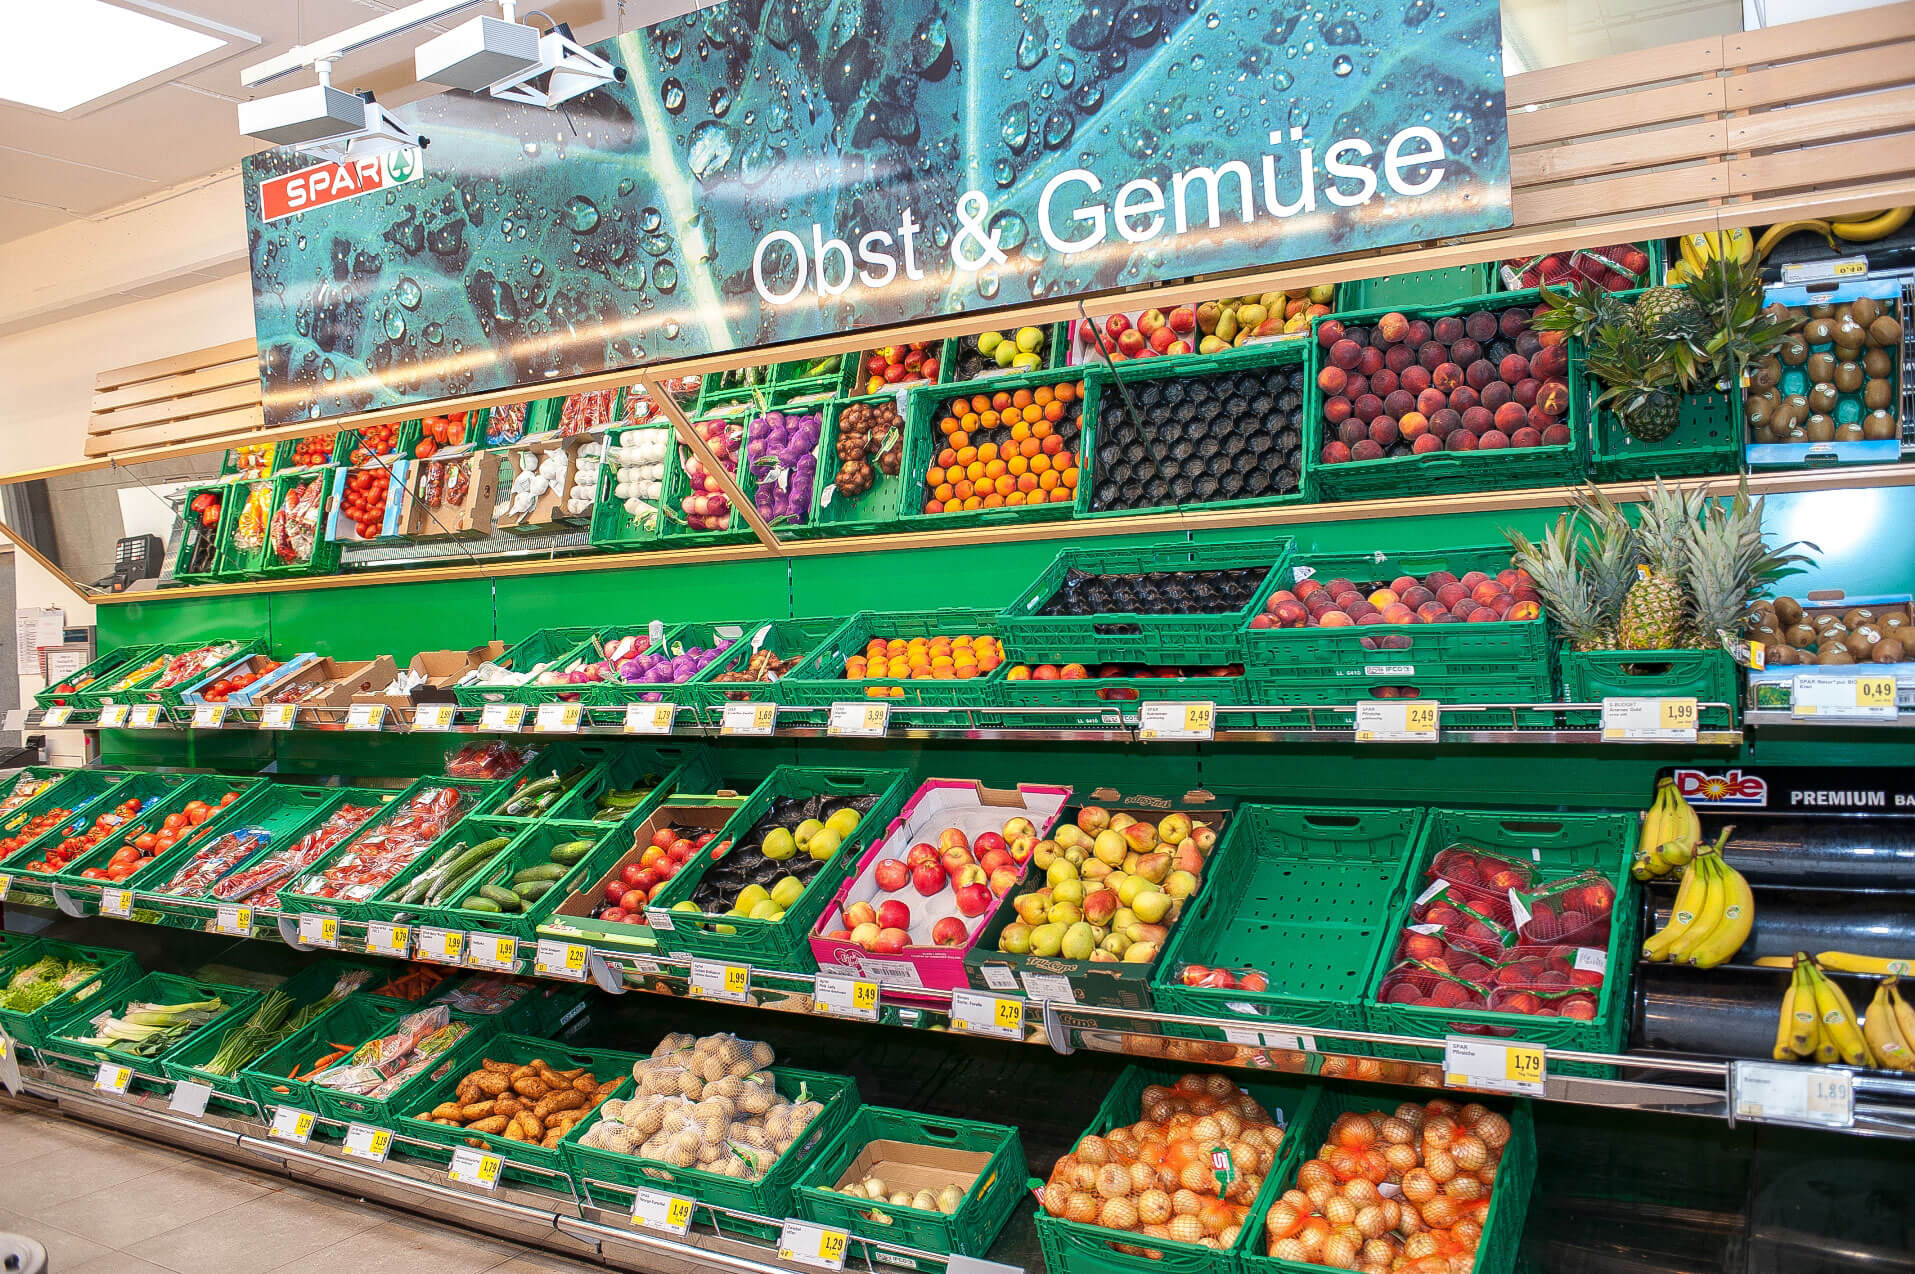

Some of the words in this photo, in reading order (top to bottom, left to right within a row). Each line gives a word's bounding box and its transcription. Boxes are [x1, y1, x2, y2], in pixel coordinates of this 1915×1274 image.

[286, 157, 380, 207] SPAR
[752, 205, 925, 306] Obst
[950, 189, 1009, 272] &
[1037, 125, 1447, 254] Gemüse
[1863, 683, 1892, 698] 0,49
[758, 710, 773, 721] 1,69
[867, 710, 884, 722] 3,99
[1190, 710, 1210, 723] 2,49
[1411, 710, 1434, 723] 2,49
[1668, 705, 1693, 719] 1,99
[1676, 770, 1764, 798] Dole
[1791, 791, 1885, 806] PREMIUM
[499, 943, 512, 955] 1,99
[570, 950, 584, 961] 2,29
[729, 971, 745, 984] 1,99
[857, 987, 875, 1001] 3,49
[1000, 1005, 1019, 1020] 2,79
[1514, 1055, 1540, 1070] 1,79
[672, 1204, 689, 1218] 1,49
[825, 1236, 843, 1251] 1,29
